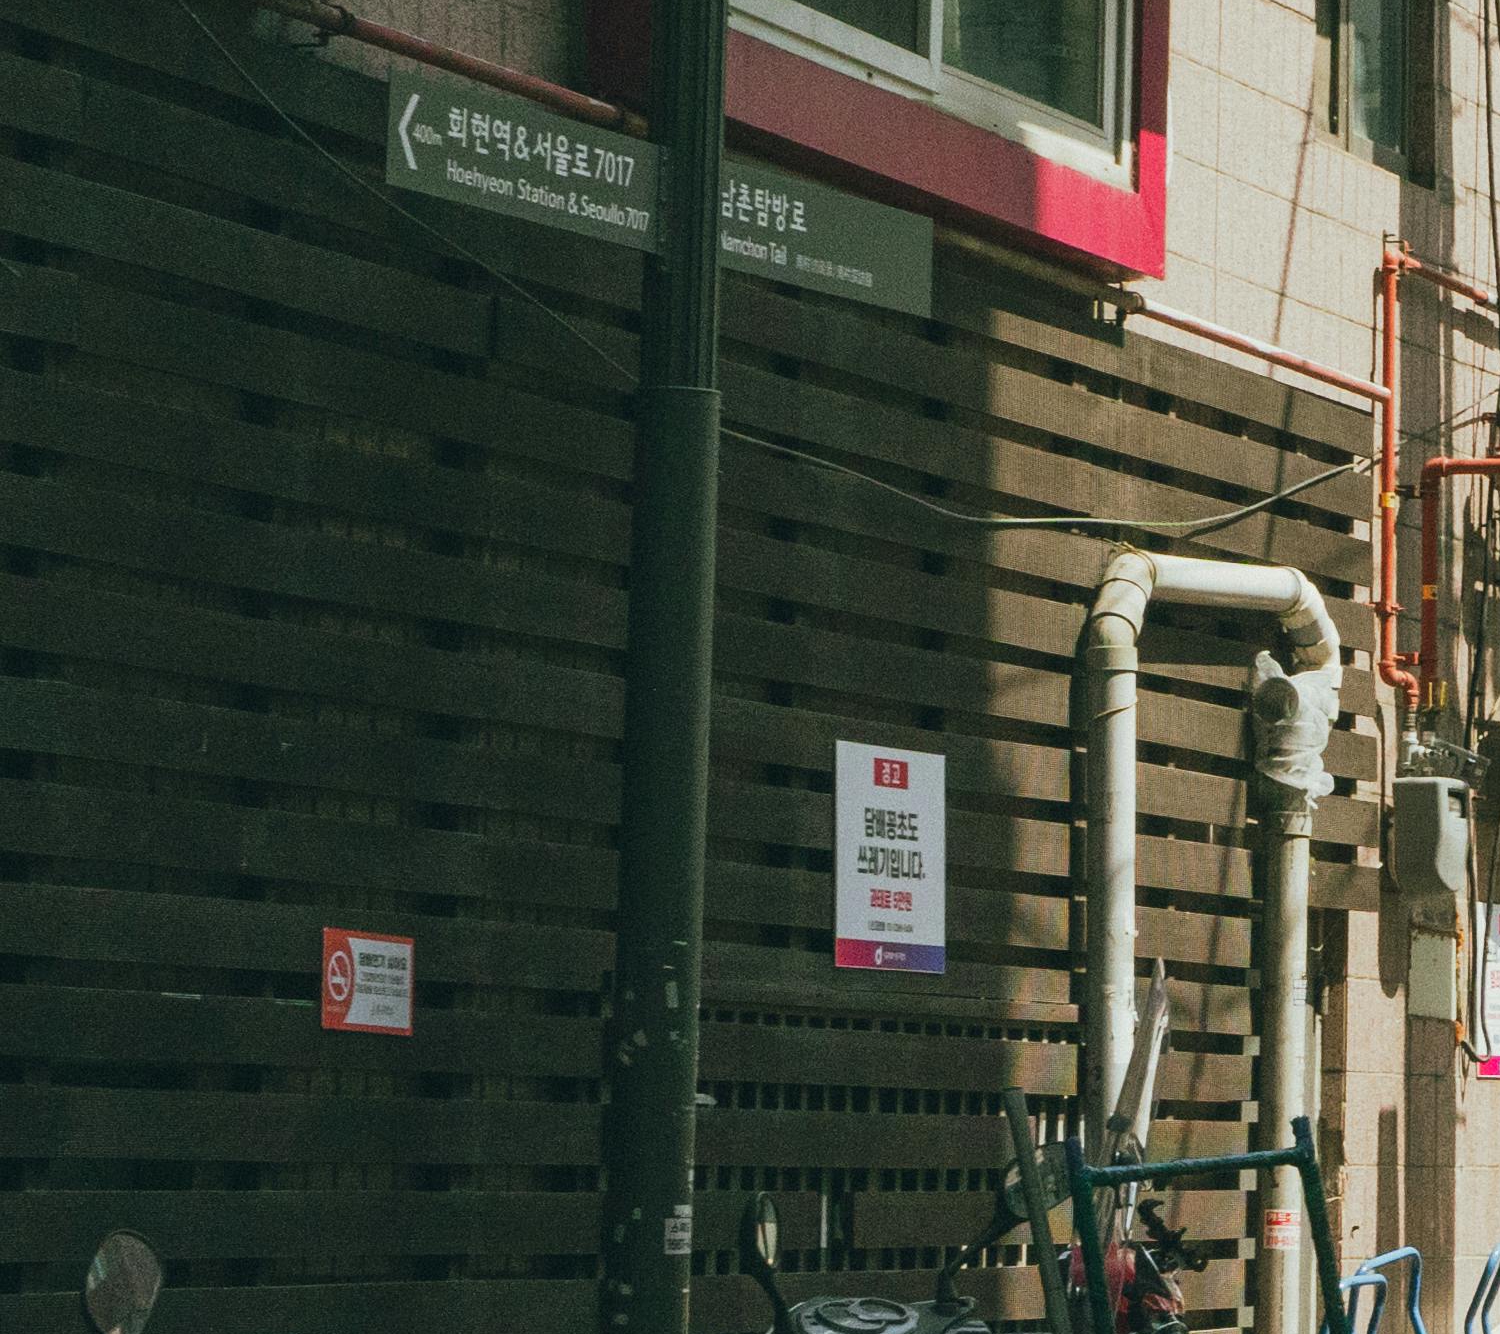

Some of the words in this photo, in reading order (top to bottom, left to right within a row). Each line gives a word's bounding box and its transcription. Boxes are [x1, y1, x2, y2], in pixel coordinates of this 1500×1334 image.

[412, 122, 443, 147] 400m
[447, 158, 514, 197] Hoehyeon
[517, 177, 566, 211] Station
[567, 192, 579, 215] &
[882, 762, 902, 785] 경고
[857, 845, 926, 880] 쓰레기입니다.
